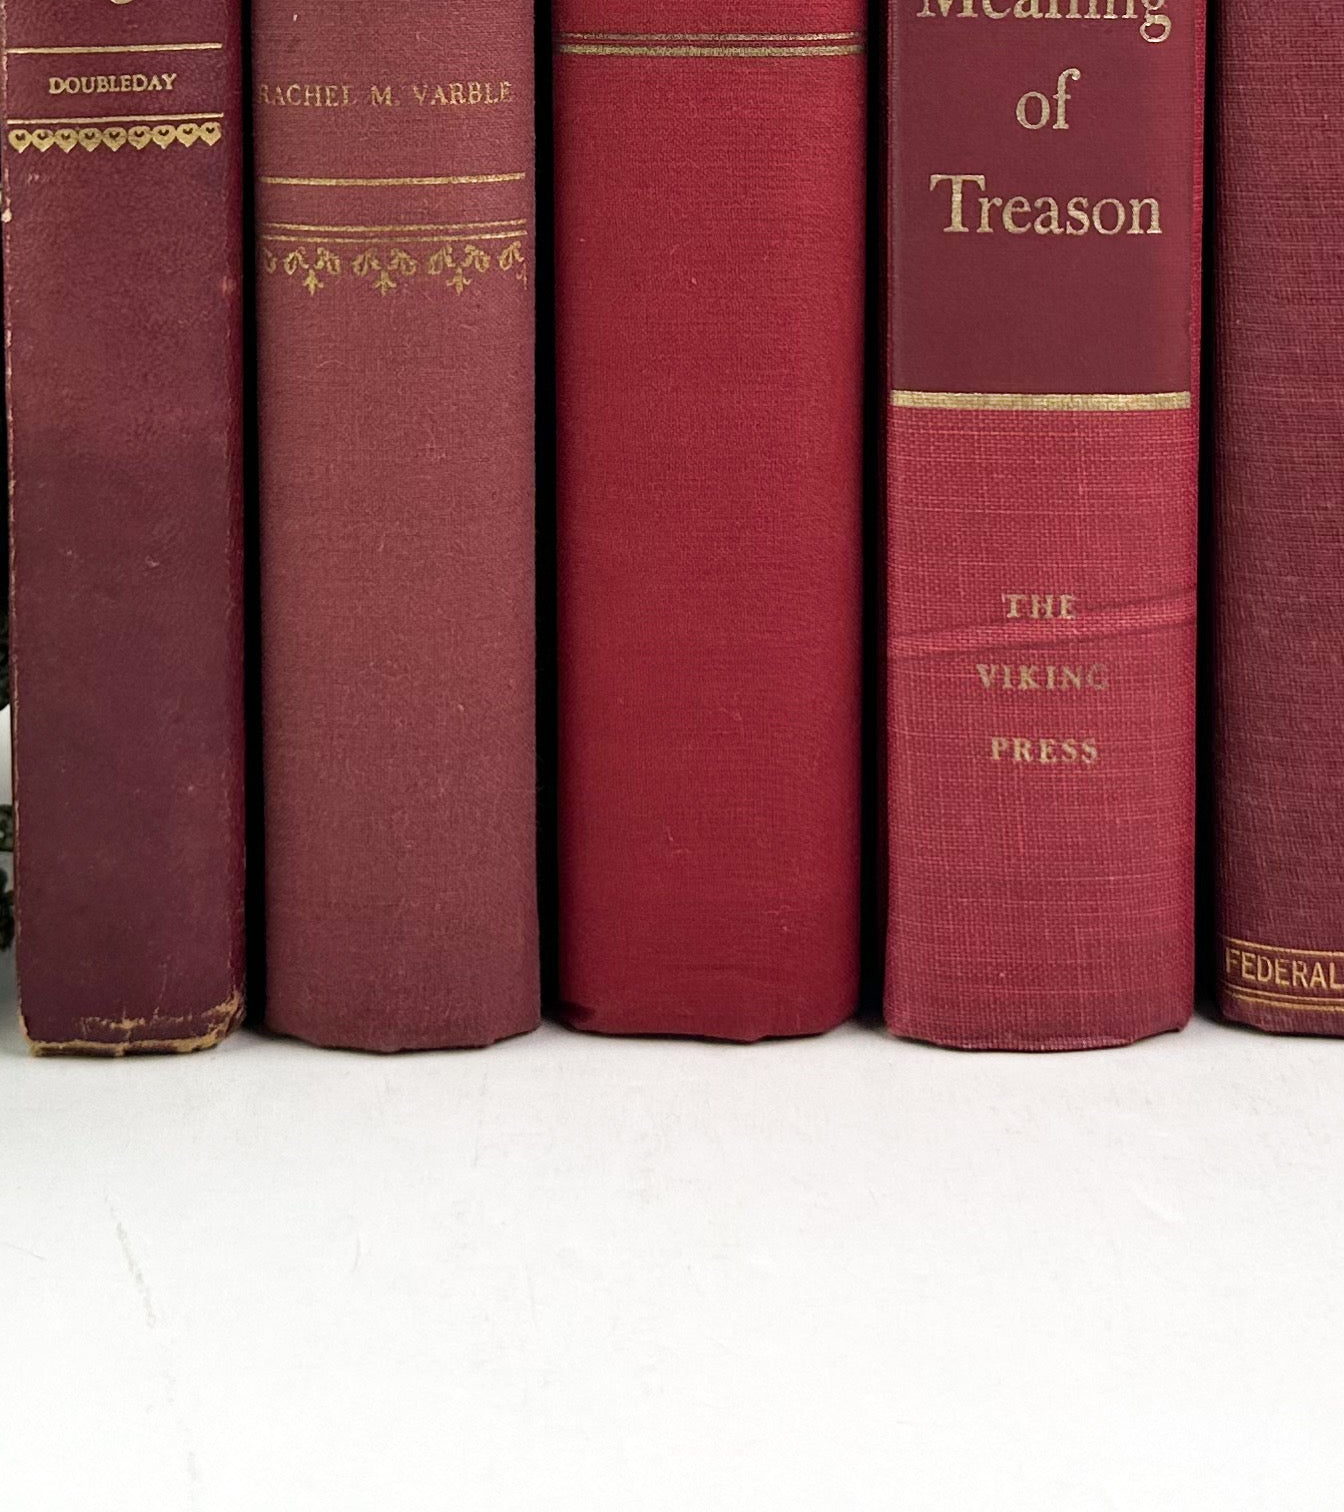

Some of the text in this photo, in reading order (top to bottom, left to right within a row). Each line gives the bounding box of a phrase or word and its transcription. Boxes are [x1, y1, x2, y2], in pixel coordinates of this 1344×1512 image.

[48, 72, 178, 95] DOUBLEDAY
[256, 82, 357, 107] RACHEL
[407, 80, 512, 107] VARBLE
[1014, 67, 1082, 131] of
[929, 173, 1164, 236] Treason
[1005, 592, 1077, 620] THE
[975, 662, 1110, 691] VIKING
[990, 736, 1099, 764] PRESS
